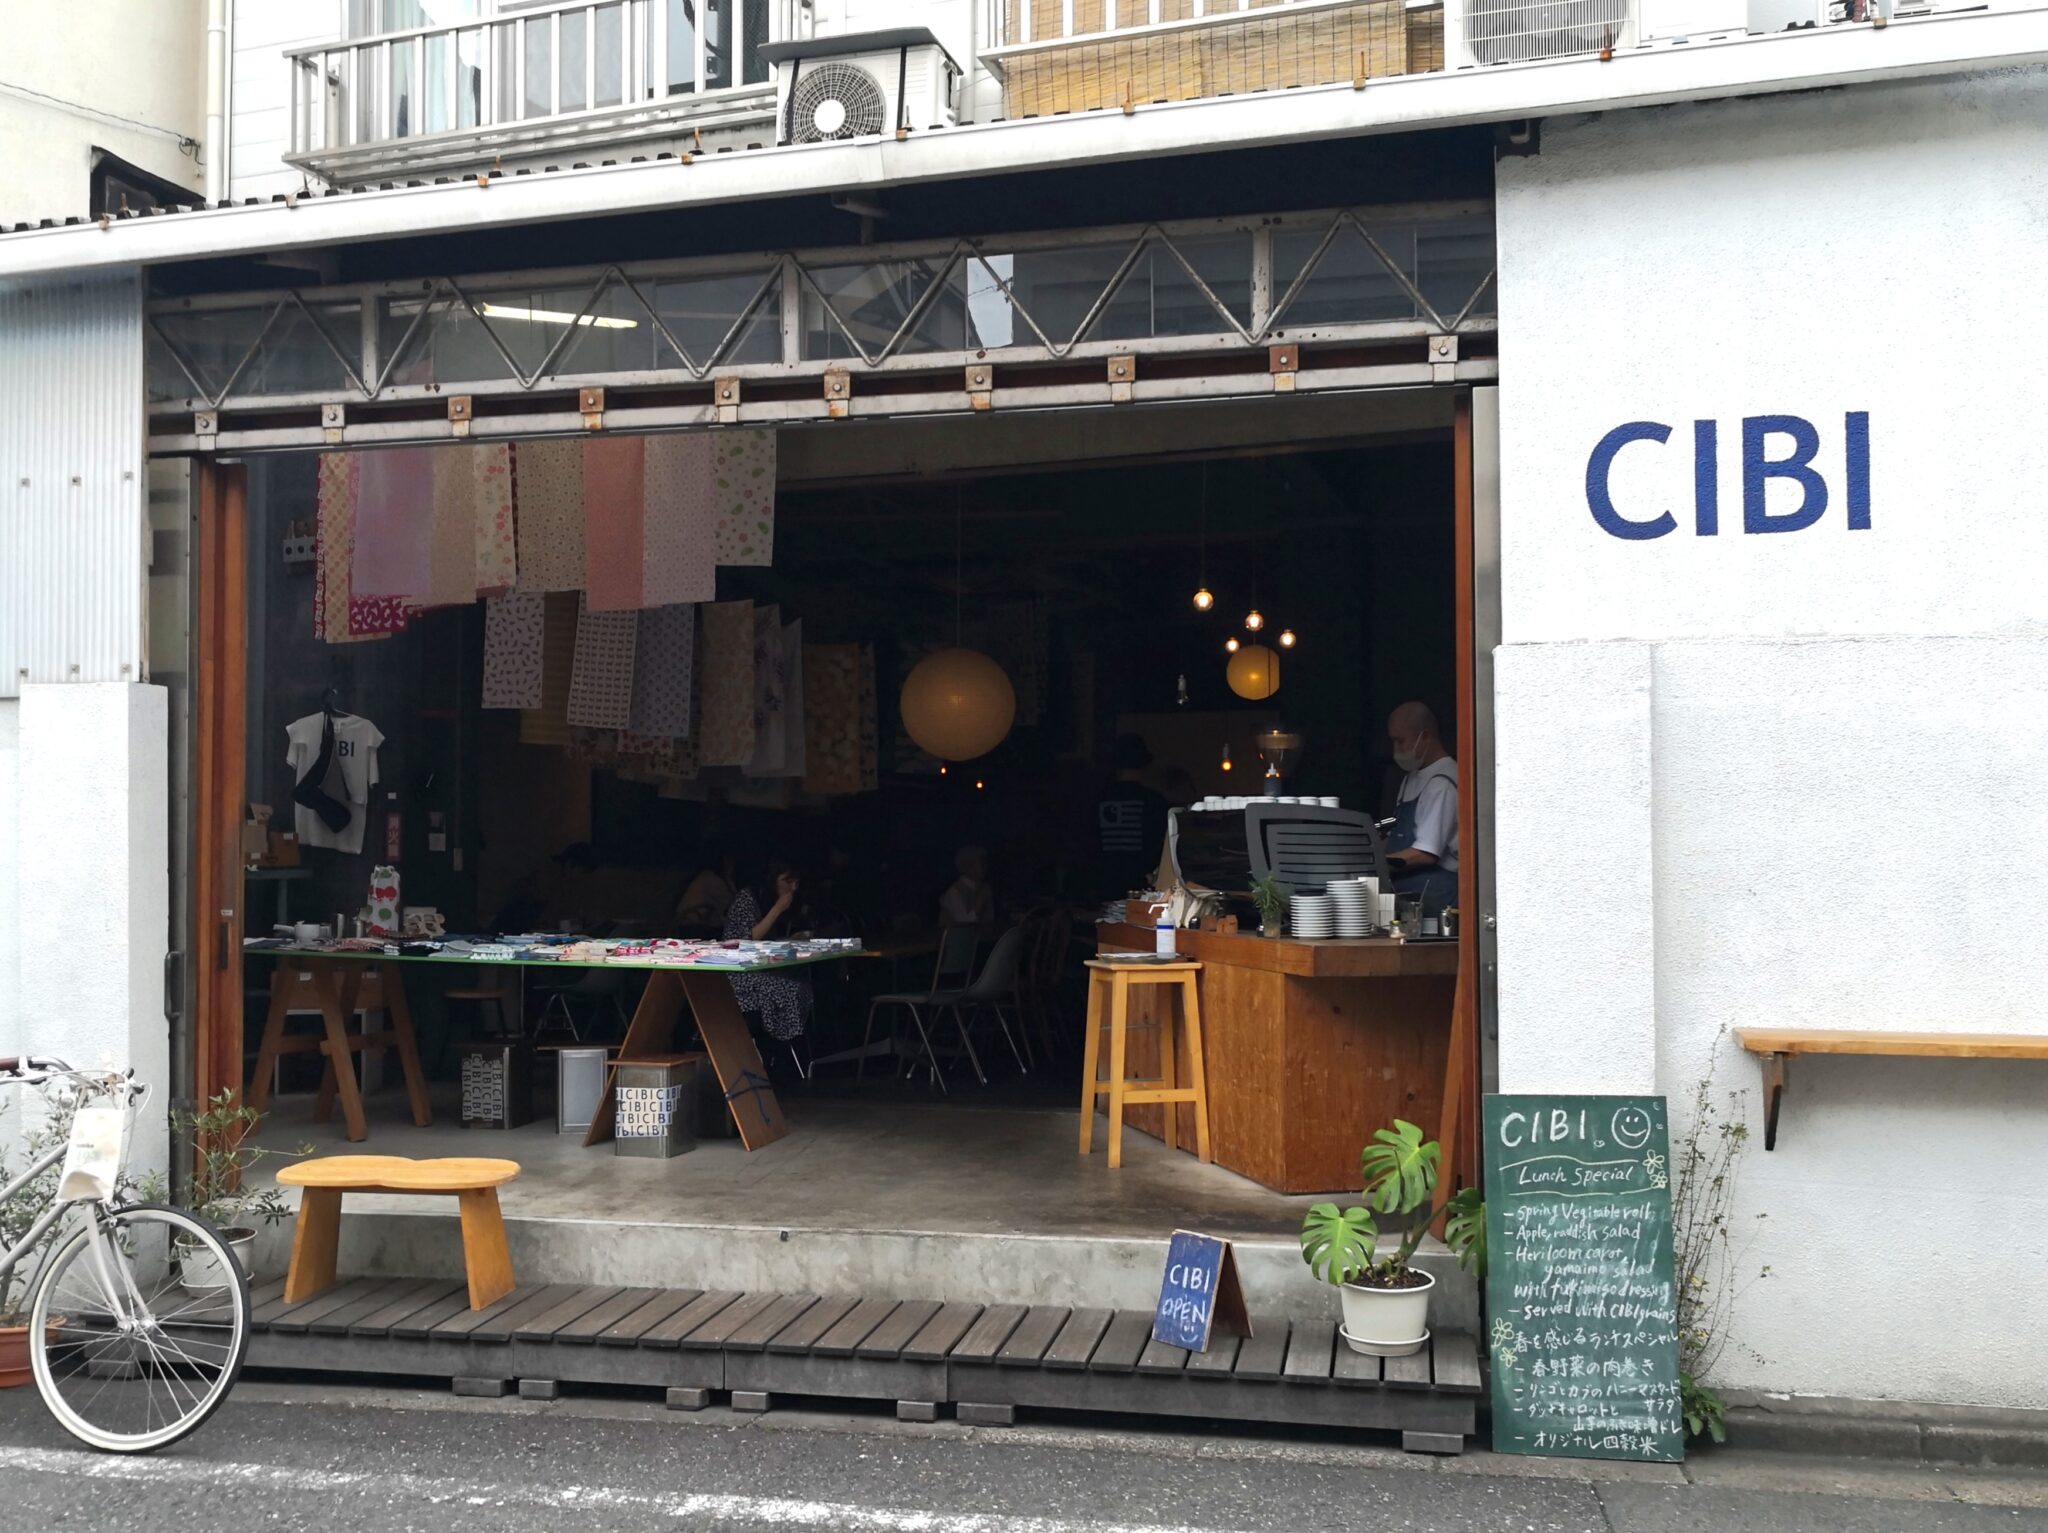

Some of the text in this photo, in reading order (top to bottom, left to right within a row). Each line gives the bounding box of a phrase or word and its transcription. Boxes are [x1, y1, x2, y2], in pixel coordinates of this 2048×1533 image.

[1585, 411, 1871, 541] CIBI
[1519, 1166, 1633, 1187] Lunch Special
[1170, 1264, 1210, 1294] CIBI
[1162, 1297, 1206, 1323] OPEN
[1532, 1354, 1655, 1378] 春野菜の肉巻き
